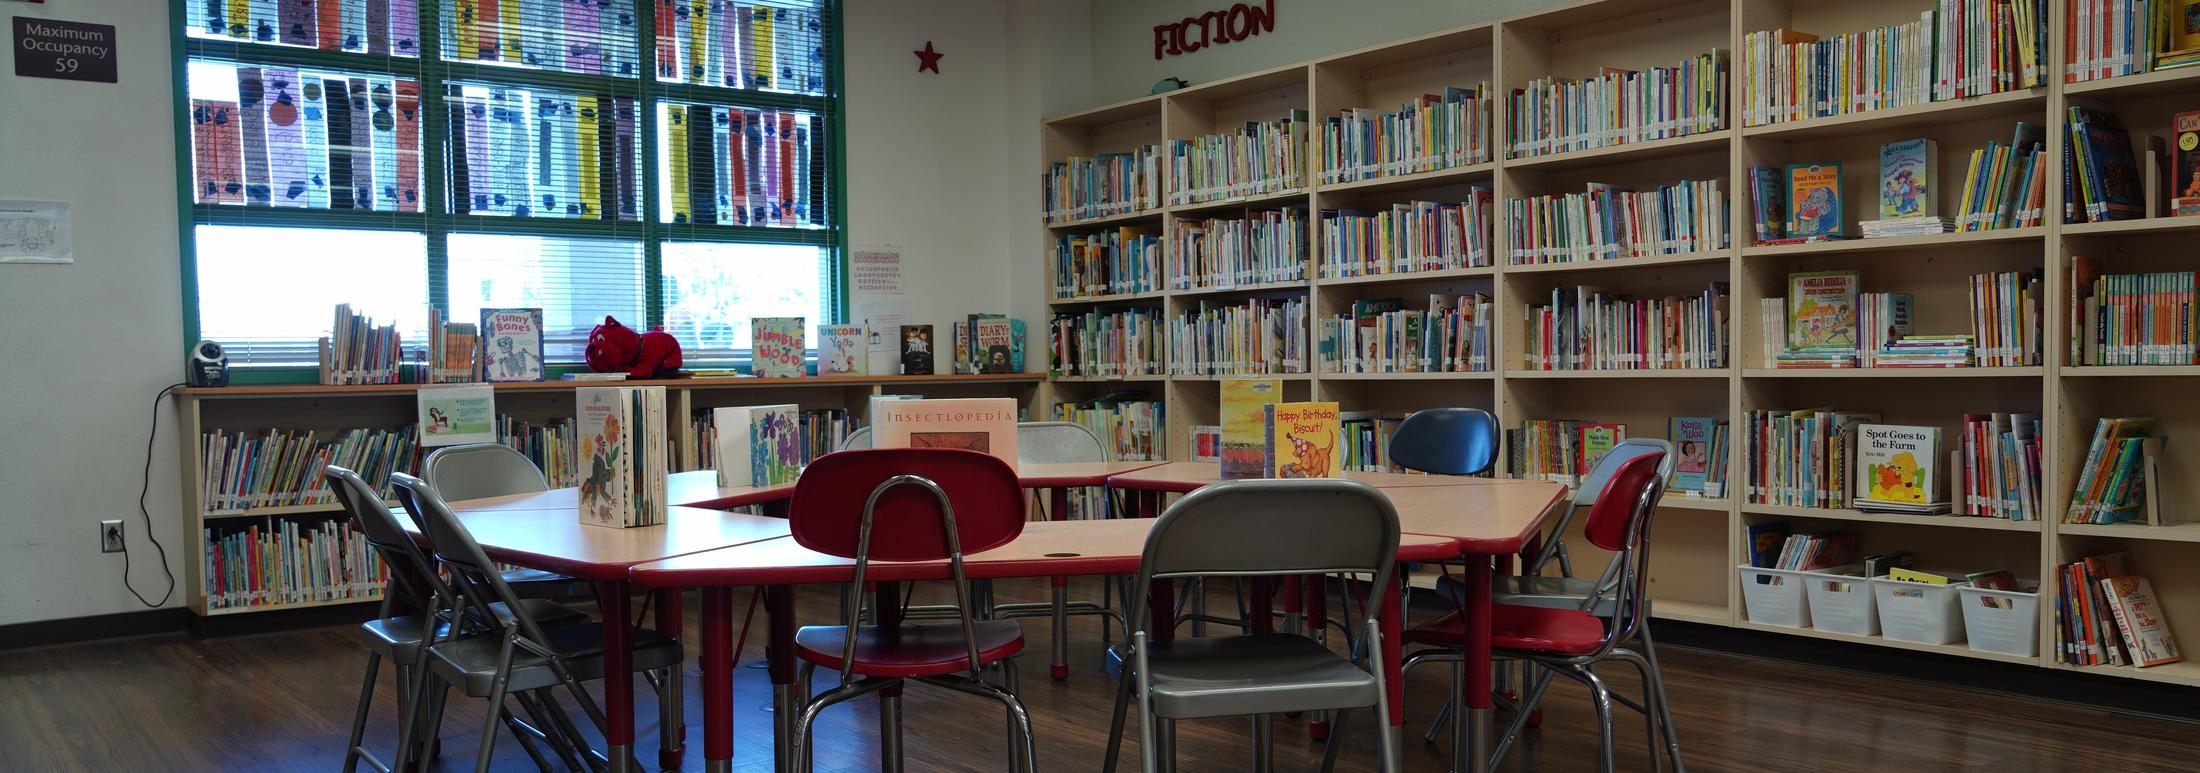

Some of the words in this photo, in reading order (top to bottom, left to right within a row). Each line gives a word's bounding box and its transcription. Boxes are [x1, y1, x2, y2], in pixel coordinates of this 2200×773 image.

[26, 23, 103, 41] Maximum
[1153, 0, 1275, 60] FICTION
[22, 38, 108, 59] Occupancy
[55, 58, 79, 73] 59
[496, 314, 528, 325] Funny
[496, 323, 531, 332] Bones
[820, 327, 862, 336] UNICORN
[980, 325, 1006, 336] DIARY
[830, 337, 854, 348] Yoga
[981, 337, 1010, 346] WORM
[1277, 409, 1300, 423] Happy
[1302, 409, 1338, 422] Birthday,
[1293, 421, 1323, 434] Biscuit!
[1866, 428, 1887, 439] Spot
[1889, 430, 1914, 439] Goes
[1916, 432, 1926, 441] to
[1872, 440, 1887, 449] the
[1889, 440, 1916, 450] Farm
